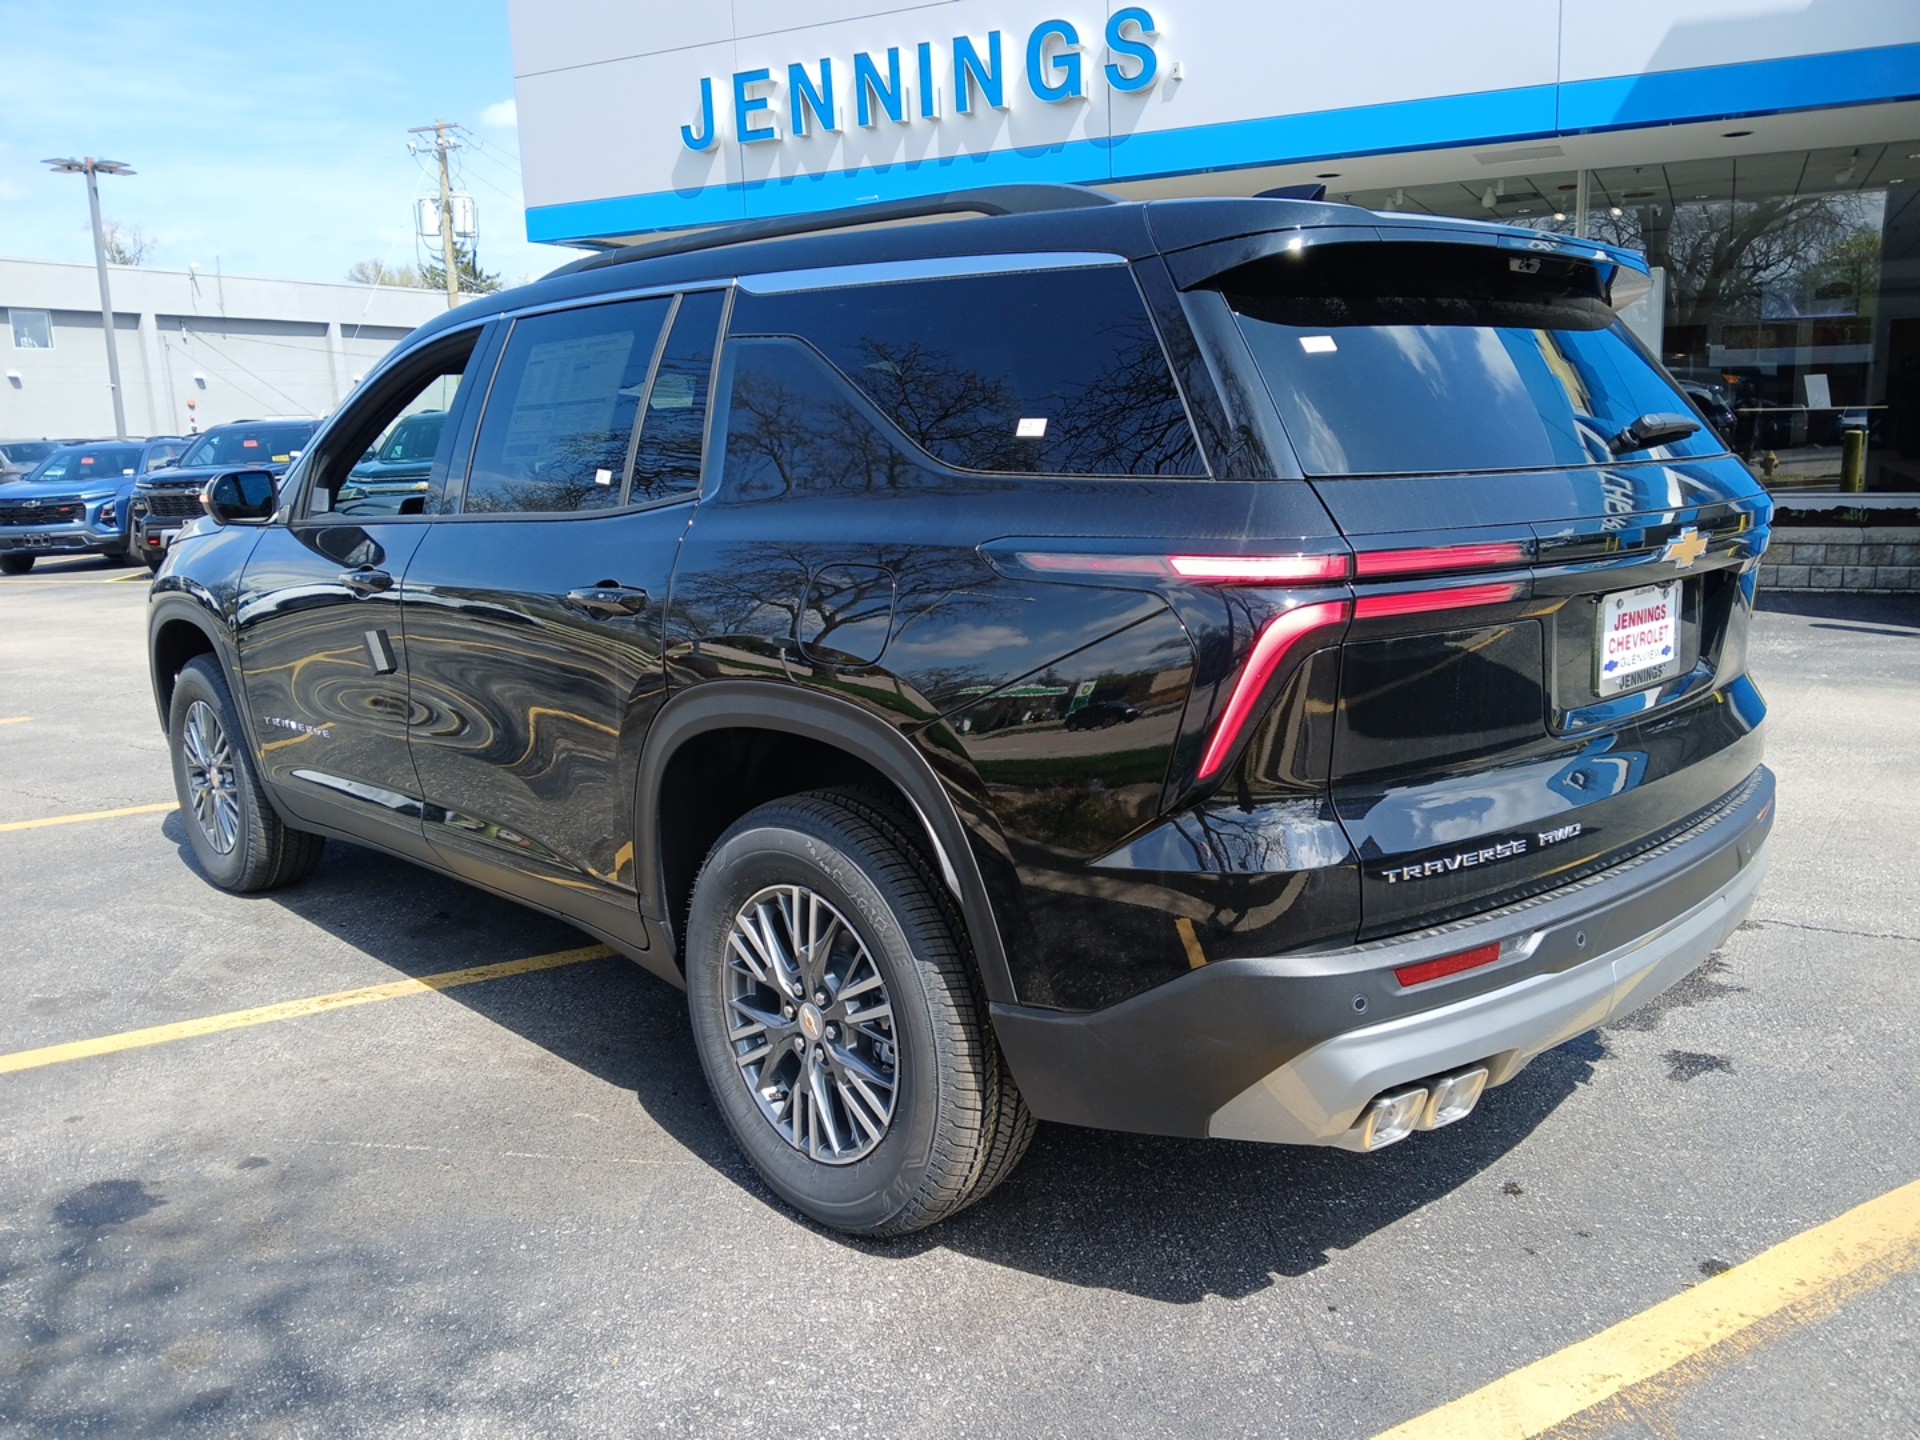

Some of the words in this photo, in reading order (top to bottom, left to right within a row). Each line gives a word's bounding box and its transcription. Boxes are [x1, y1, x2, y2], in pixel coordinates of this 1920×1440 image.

[679, 6, 1159, 153] JENNINGS
[1614, 604, 1667, 631] JENNINGS
[1608, 624, 1669, 655] CHEVROLET
[1619, 664, 1666, 690] JENNINGS
[1382, 838, 1528, 884] TRAVERSE
[1538, 822, 1583, 847] AWD
